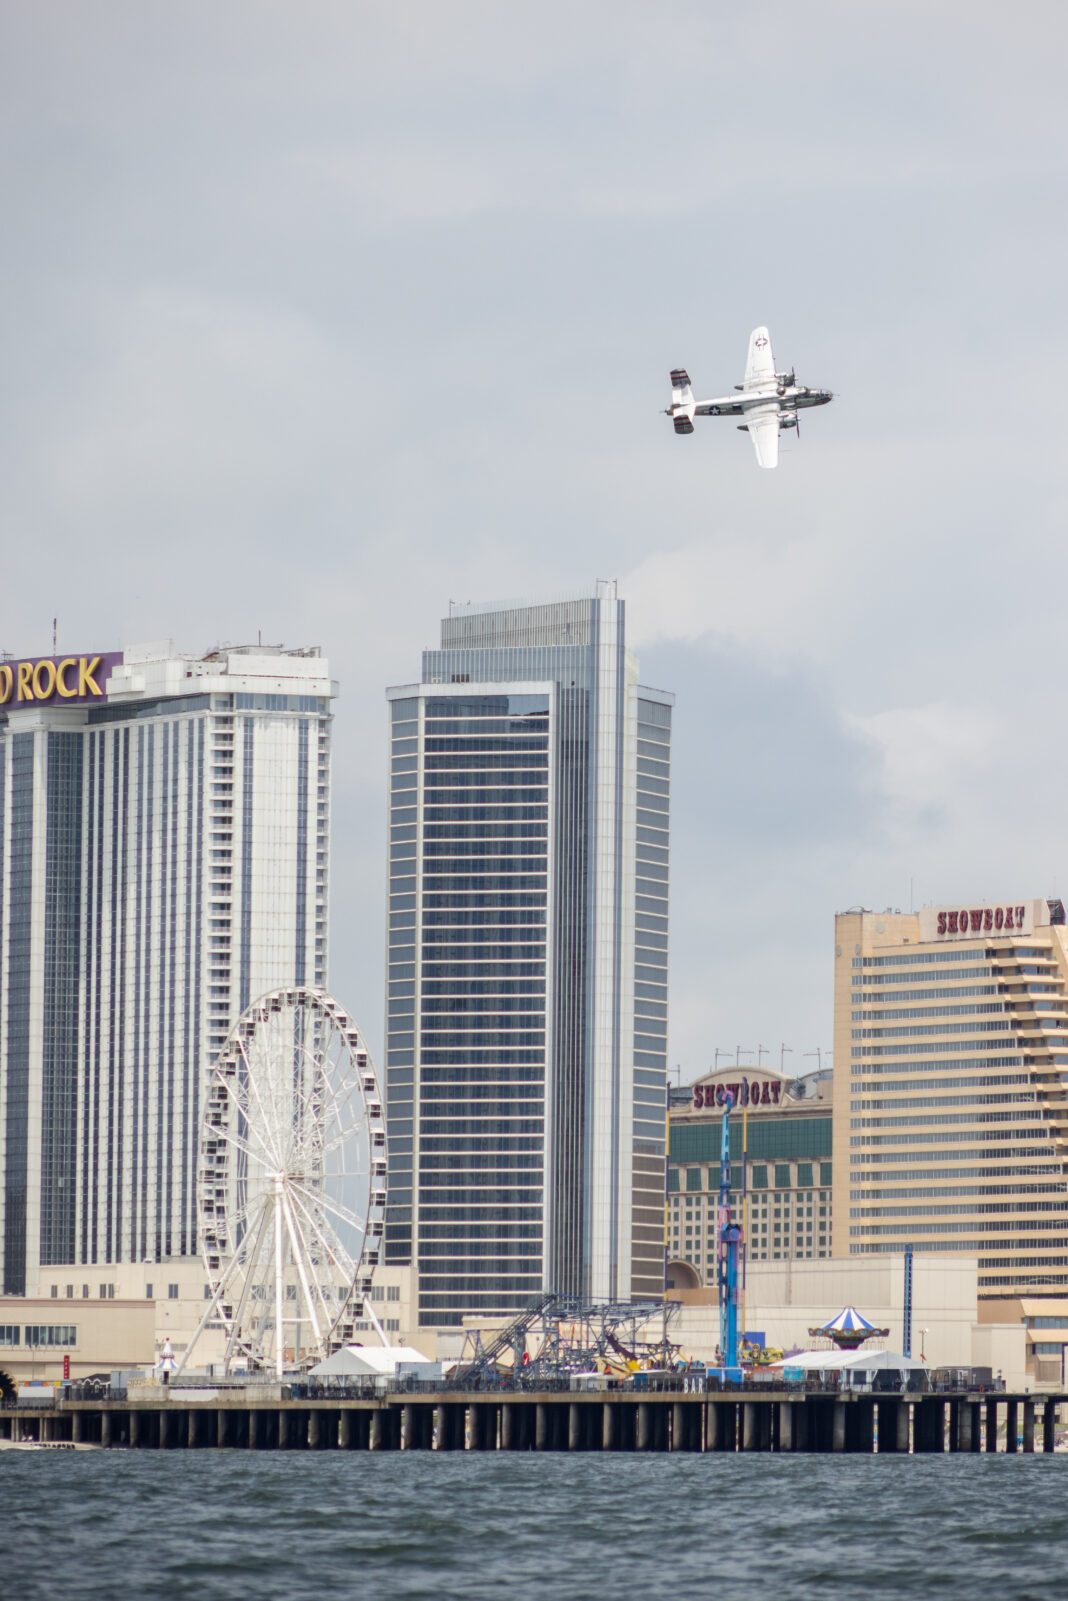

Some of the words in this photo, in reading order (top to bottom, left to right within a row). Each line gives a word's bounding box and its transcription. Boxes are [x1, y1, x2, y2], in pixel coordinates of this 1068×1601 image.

[18, 657, 104, 701] ROCK
[937, 906, 1025, 935] SHOWBOAT
[684, 1377, 703, 1394] BAR
